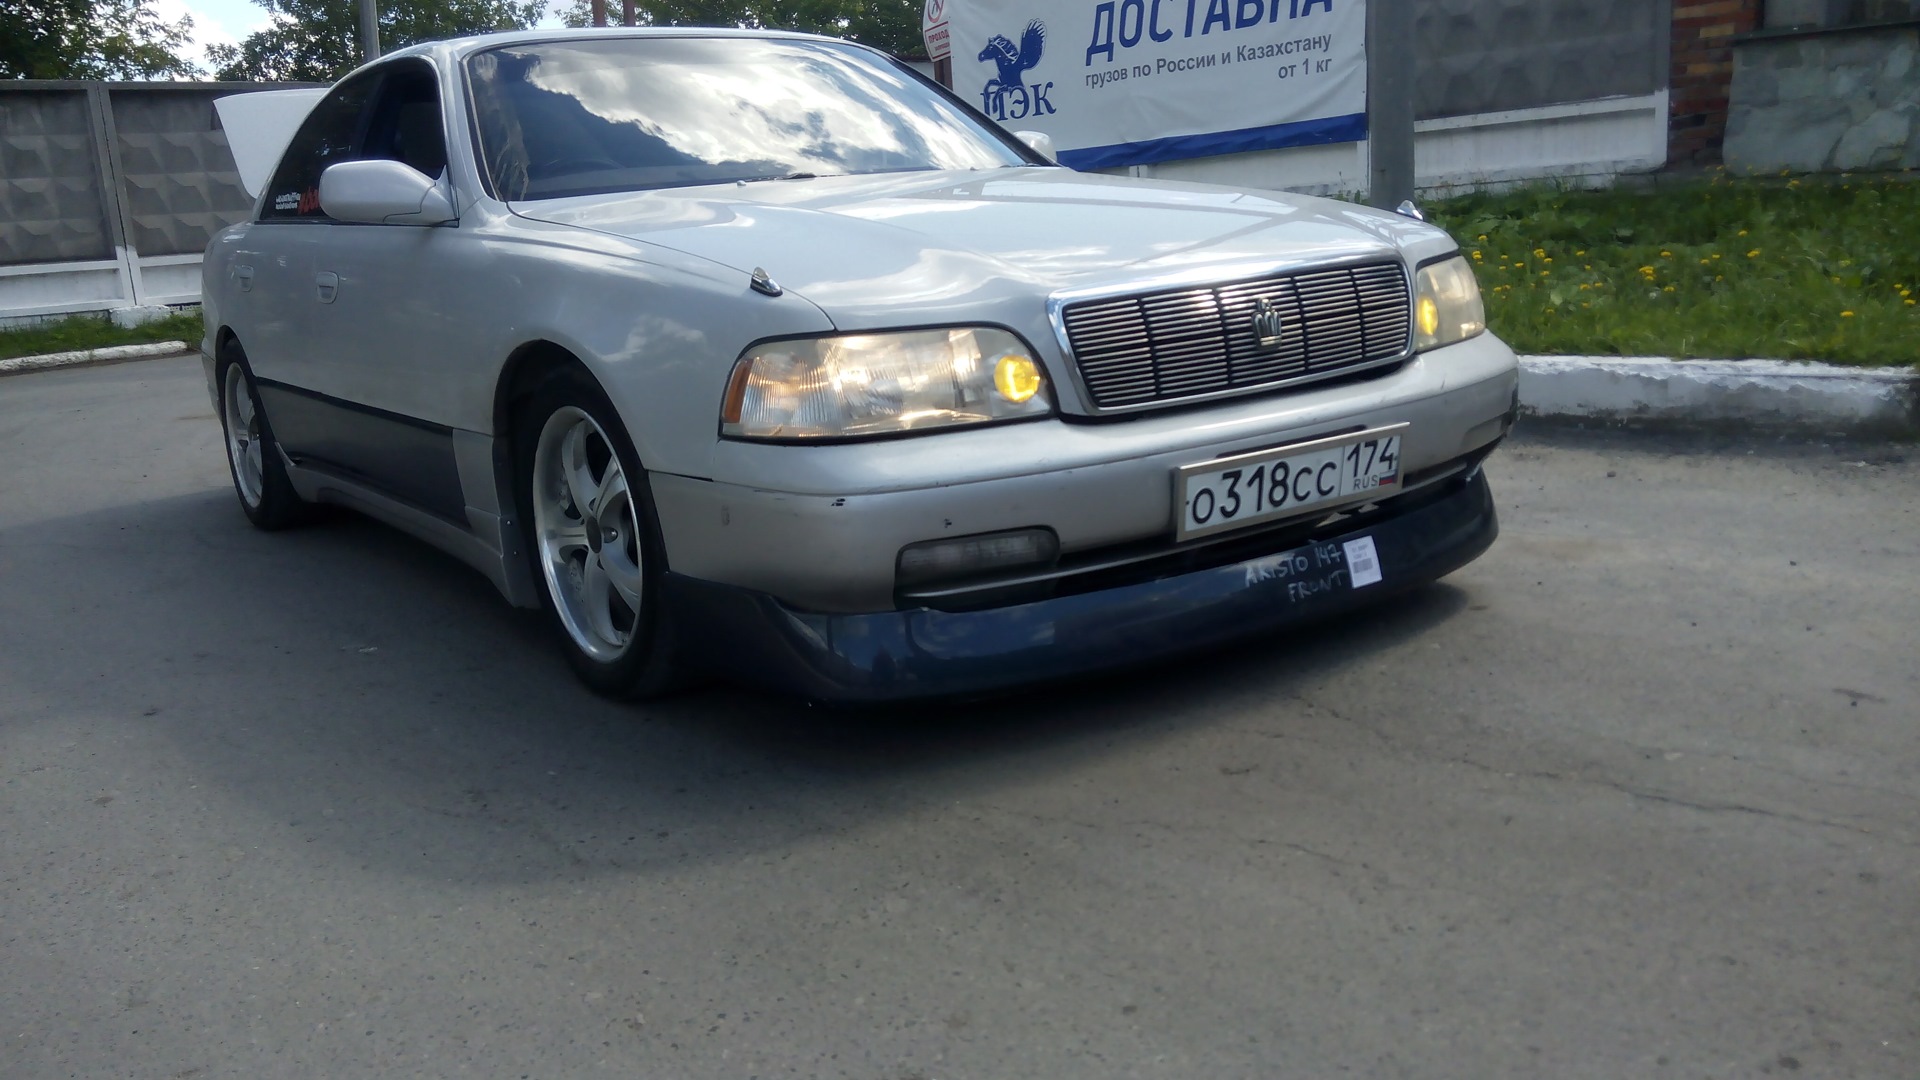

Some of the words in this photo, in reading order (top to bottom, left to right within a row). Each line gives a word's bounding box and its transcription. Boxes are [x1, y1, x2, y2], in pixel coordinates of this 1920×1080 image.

[1085, 67, 1128, 89] грузов
[1132, 64, 1151, 79] по
[1156, 54, 1216, 75] России
[1221, 54, 1231, 66] и
[1237, 34, 1332, 63] Казахстану
[1278, 64, 1296, 79] от
[1302, 61, 1310, 75] 1
[1316, 58, 1332, 73] кг
[980, 81, 1057, 121] ПЭК
[1347, 437, 1396, 478] 174
[1353, 474, 1379, 491] RUS
